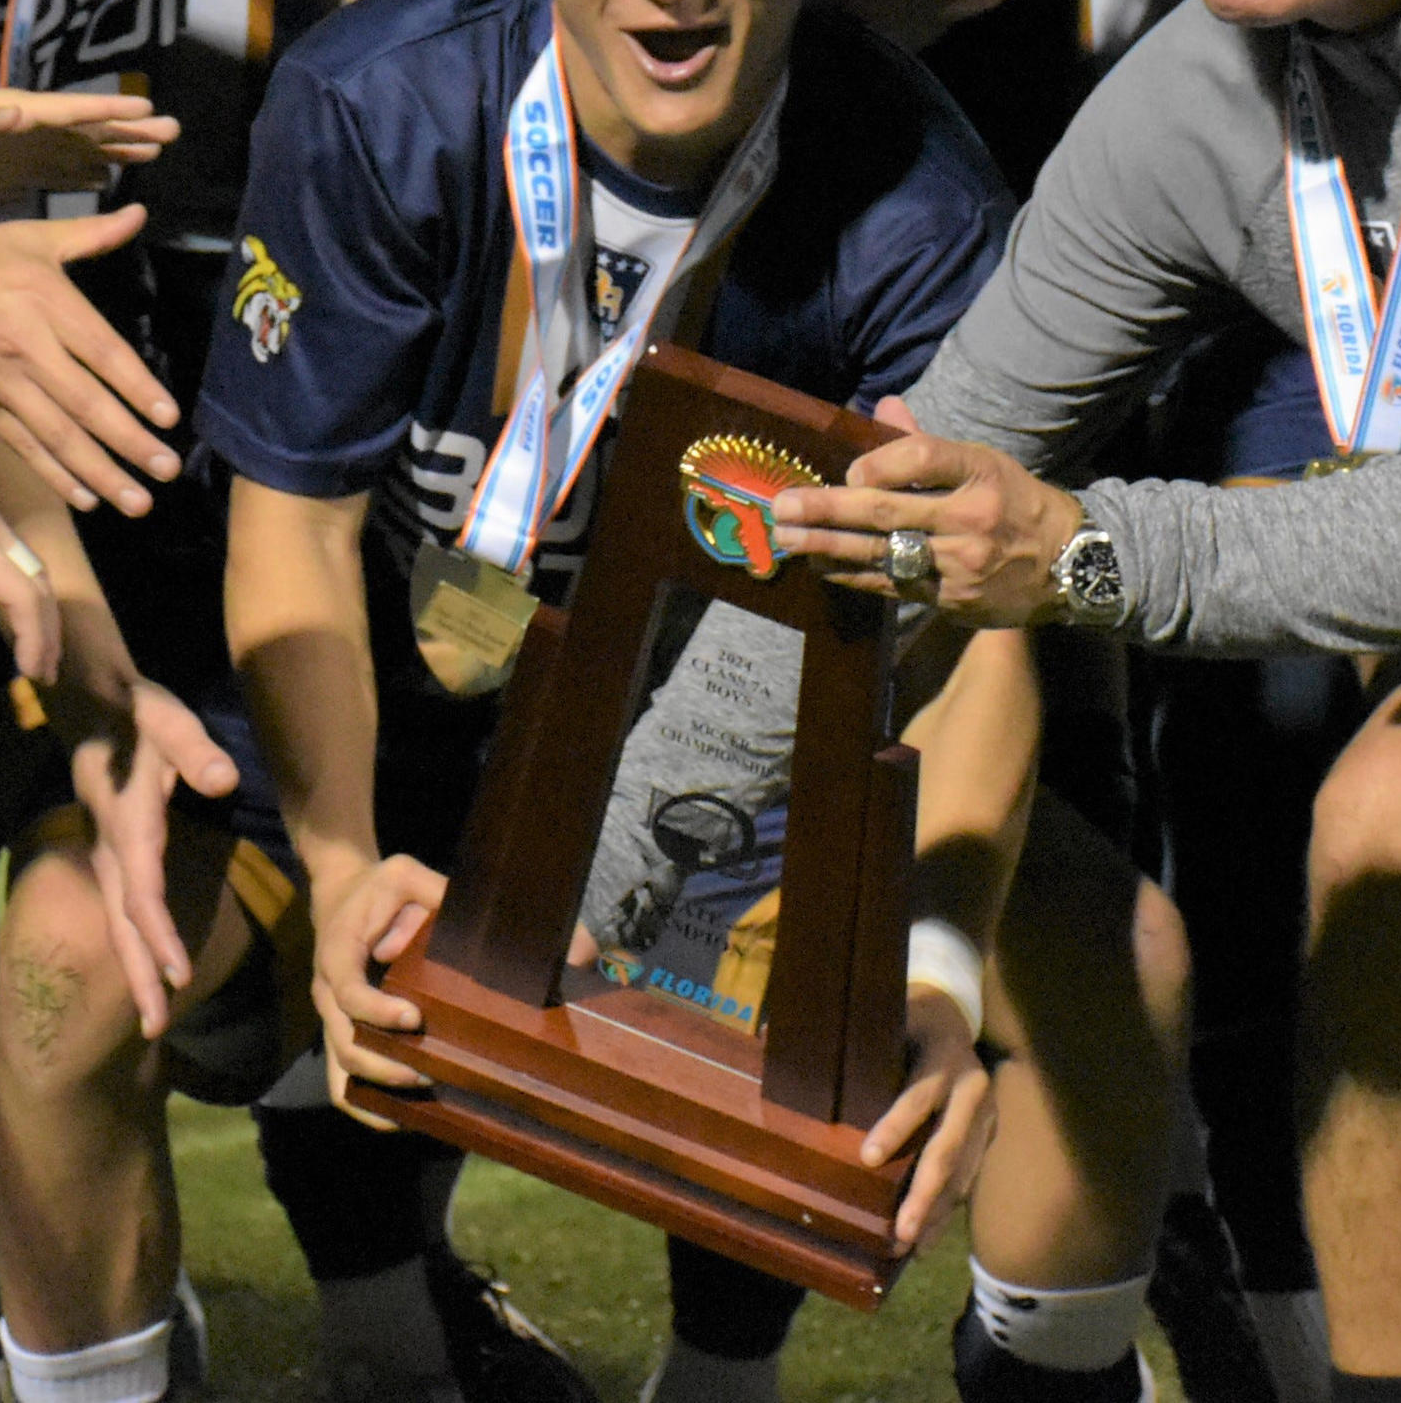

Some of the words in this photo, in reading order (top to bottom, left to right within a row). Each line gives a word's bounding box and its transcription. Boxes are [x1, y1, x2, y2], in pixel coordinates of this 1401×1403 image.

[524, 100, 556, 249] SOCCER
[1334, 302, 1360, 377] FLORIDA
[691, 657, 747, 687] CLASS
[751, 680, 771, 699] 7A
[718, 648, 752, 672] 2024
[706, 680, 752, 707] BOYS
[649, 967, 753, 1022] FLORIDA
